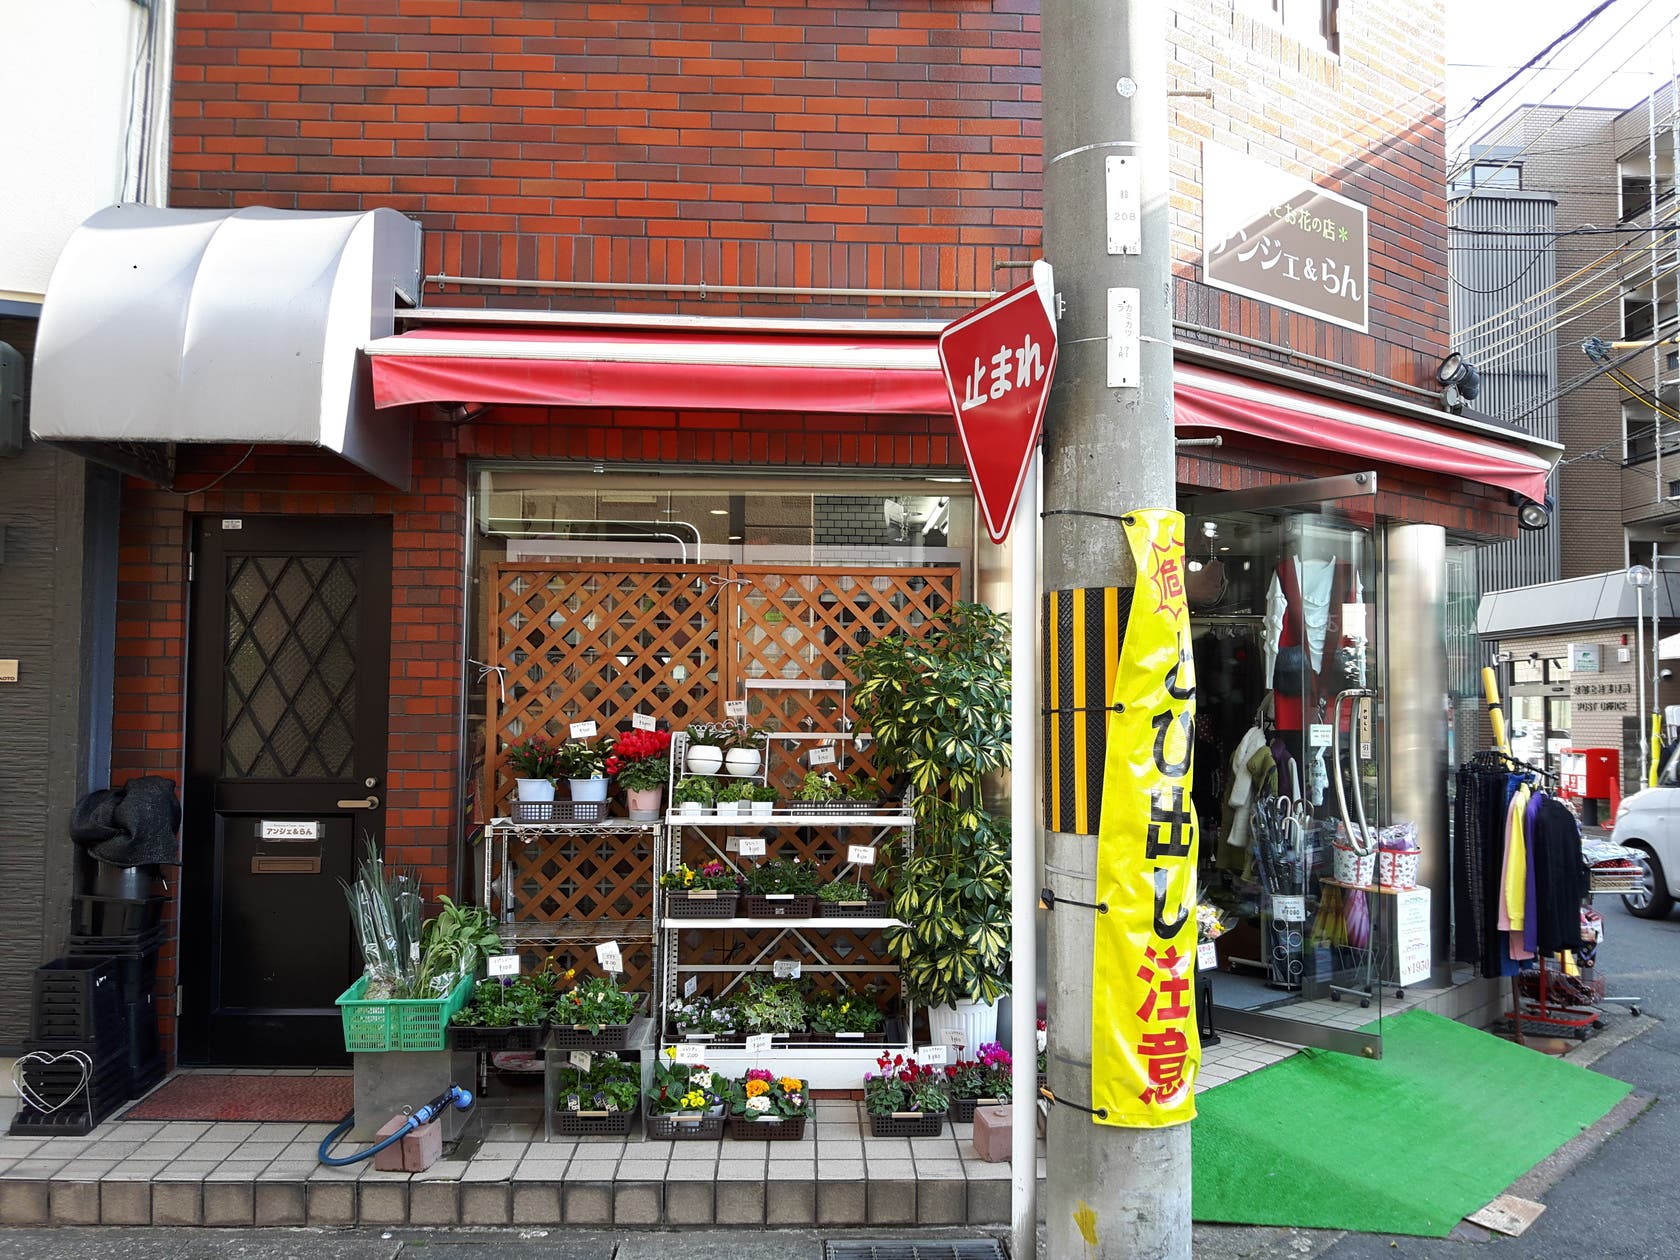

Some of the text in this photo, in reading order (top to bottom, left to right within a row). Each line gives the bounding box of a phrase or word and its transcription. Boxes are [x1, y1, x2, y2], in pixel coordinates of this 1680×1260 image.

[961, 333, 1045, 411] 止まれ
[1159, 556, 1186, 601] 危
[1577, 701, 1627, 711] POST OFFICE
